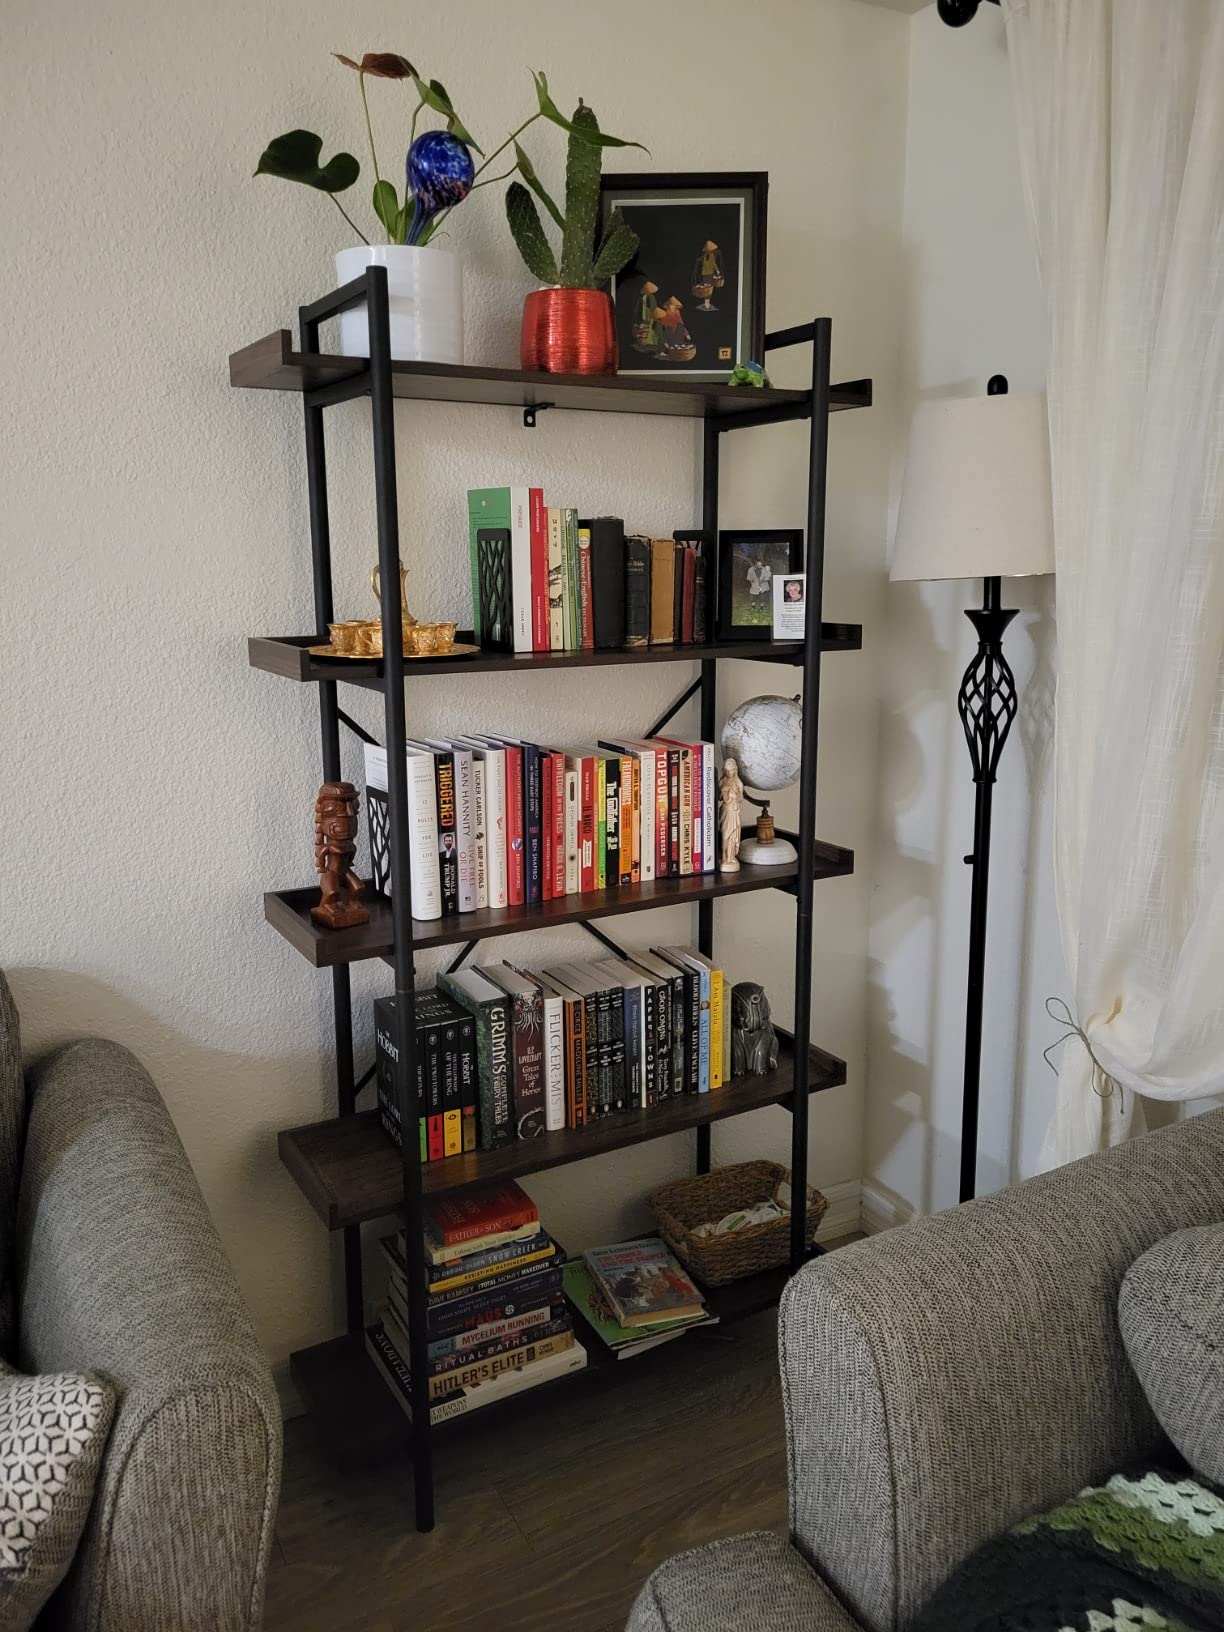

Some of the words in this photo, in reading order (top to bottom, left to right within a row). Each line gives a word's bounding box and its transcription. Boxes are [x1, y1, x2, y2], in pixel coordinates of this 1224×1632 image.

[461, 761, 470, 787] SEAN
[556, 758, 564, 797] UNFREEDOM
[622, 761, 631, 806] FREAKONOMICS
[657, 752, 667, 803] TOPGUN
[439, 762, 454, 826] TRIGGERED
[607, 781, 617, 796] The
[462, 790, 471, 838] HANNITY
[556, 813, 564, 834] PRESS
[607, 797, 618, 833] Godfather
[459, 851, 467, 865] OR
[467, 845, 475, 864] LIVE
[468, 866, 476, 888] FREE
[556, 873, 564, 892] LEVIN
[658, 991, 666, 1013] GOOD
[657, 1014, 666, 1040] OMENS
[377, 1028, 399, 1063] HOBBIT
[491, 1007, 509, 1074] GRIMM'S
[550, 1013, 561, 1072] FLICKER
[701, 1038, 708, 1050] OF
[445, 1052, 452, 1061] OF
[701, 1052, 708, 1066] ME
[461, 1052, 471, 1085] HOBBIT
[522, 1065, 540, 1073] Great
[523, 1073, 540, 1081] Tales
[494, 1076, 502, 1099] FAIRY
[521, 1088, 542, 1096] Horror
[528, 1080, 536, 1088] of
[449, 1228, 480, 1243] FATHER
[485, 1221, 502, 1233] SON
[441, 1266, 463, 1277] GREGG
[465, 1260, 485, 1268] OLSEN
[488, 1252, 510, 1264] SNOW
[513, 1243, 536, 1256] CREEK
[464, 1267, 493, 1280] RESISTING
[496, 1258, 526, 1269] HAPPINESS
[429, 1296, 444, 1306] DAVE
[446, 1286, 474, 1301] RAMSEY
[480, 1280, 497, 1289] TOTAL
[497, 1272, 521, 1282] MONEY
[521, 1262, 549, 1275] MAKEOVER
[462, 1326, 506, 1345] MYCELIUM
[507, 1312, 545, 1332] RUNNING
[463, 1309, 502, 1328] MAUS
[435, 1351, 483, 1372] RITUAL
[487, 1335, 528, 1354] BATHS
[433, 1364, 489, 1395] HITLER'S
[492, 1351, 524, 1374] ELITE
